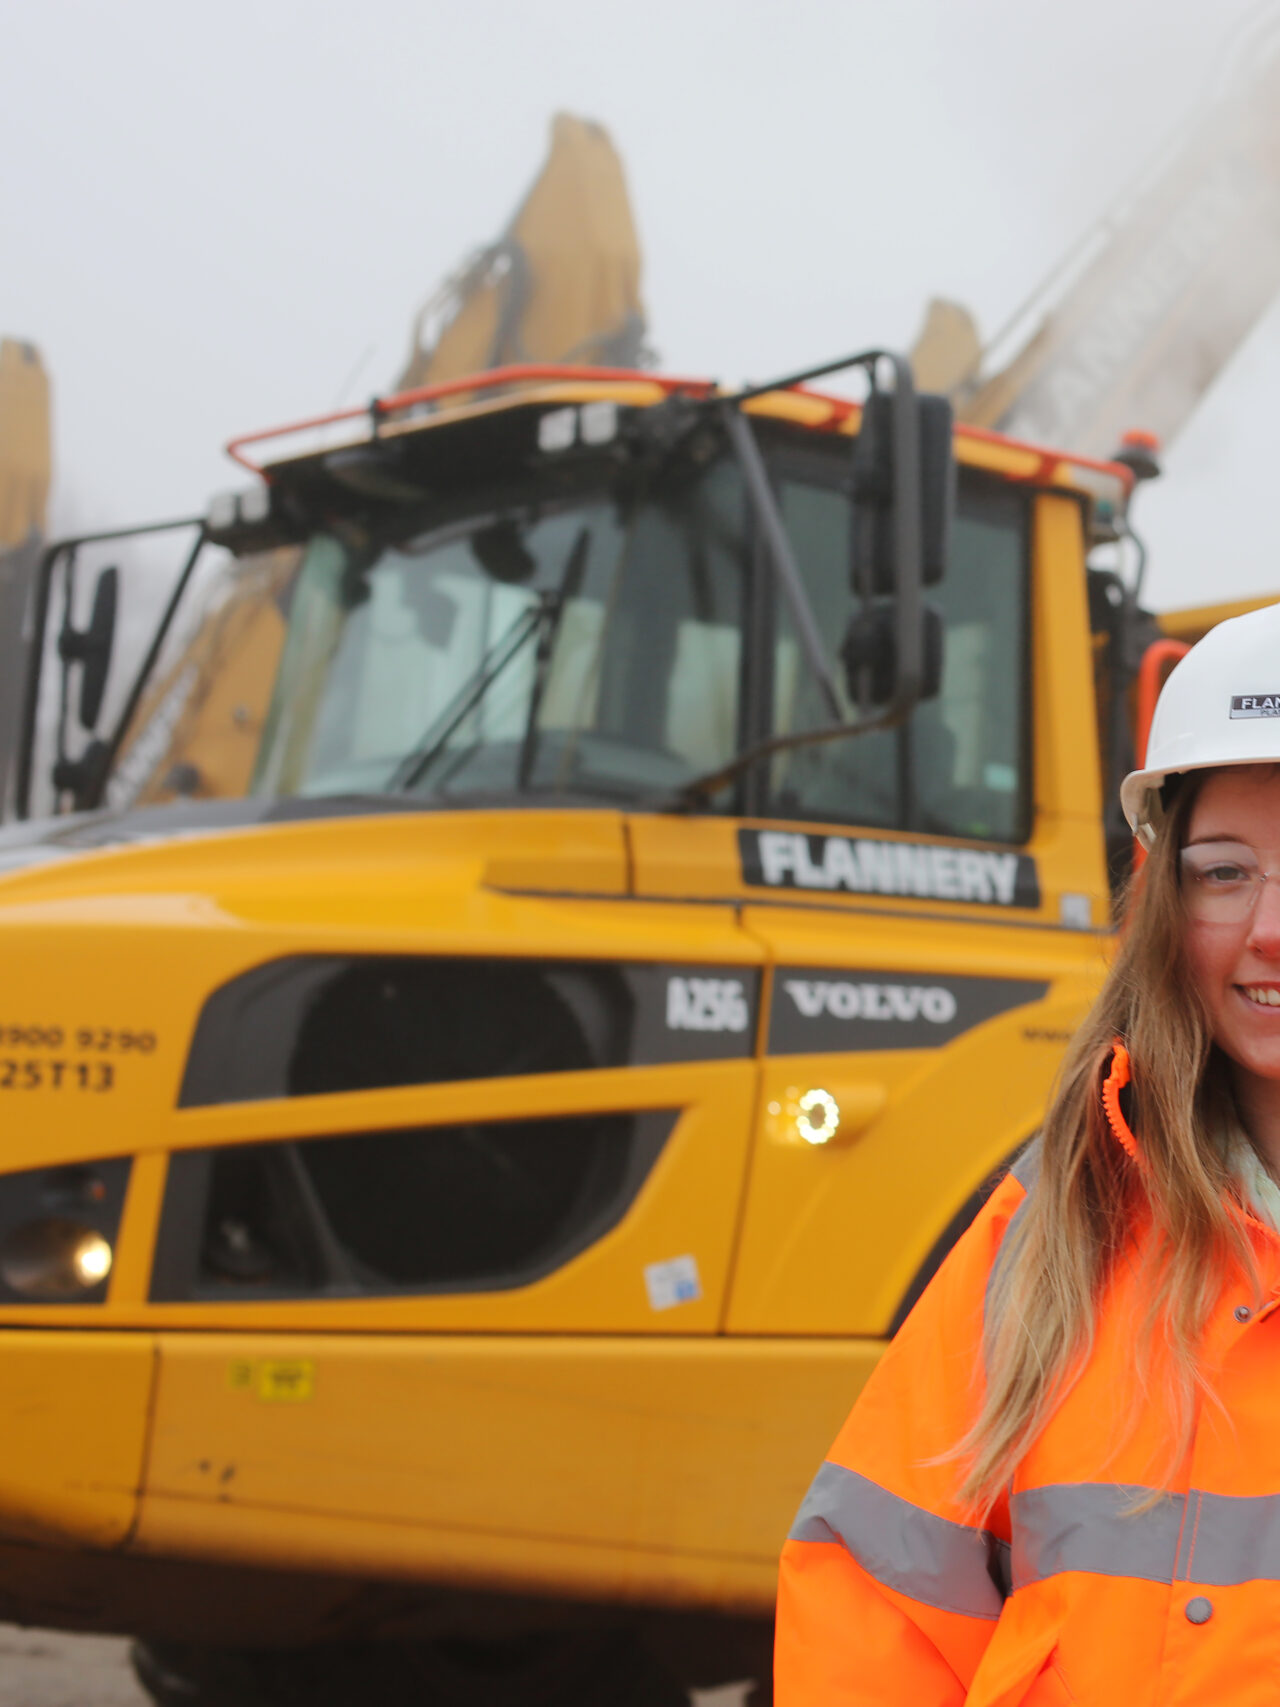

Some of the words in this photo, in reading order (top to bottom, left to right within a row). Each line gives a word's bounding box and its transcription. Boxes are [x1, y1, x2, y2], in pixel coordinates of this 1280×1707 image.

[758, 831, 1018, 904] FLANNERY
[783, 979, 958, 1024] VOLVO
[0, 1026, 64, 1049] 900
[77, 1028, 157, 1055] 9290
